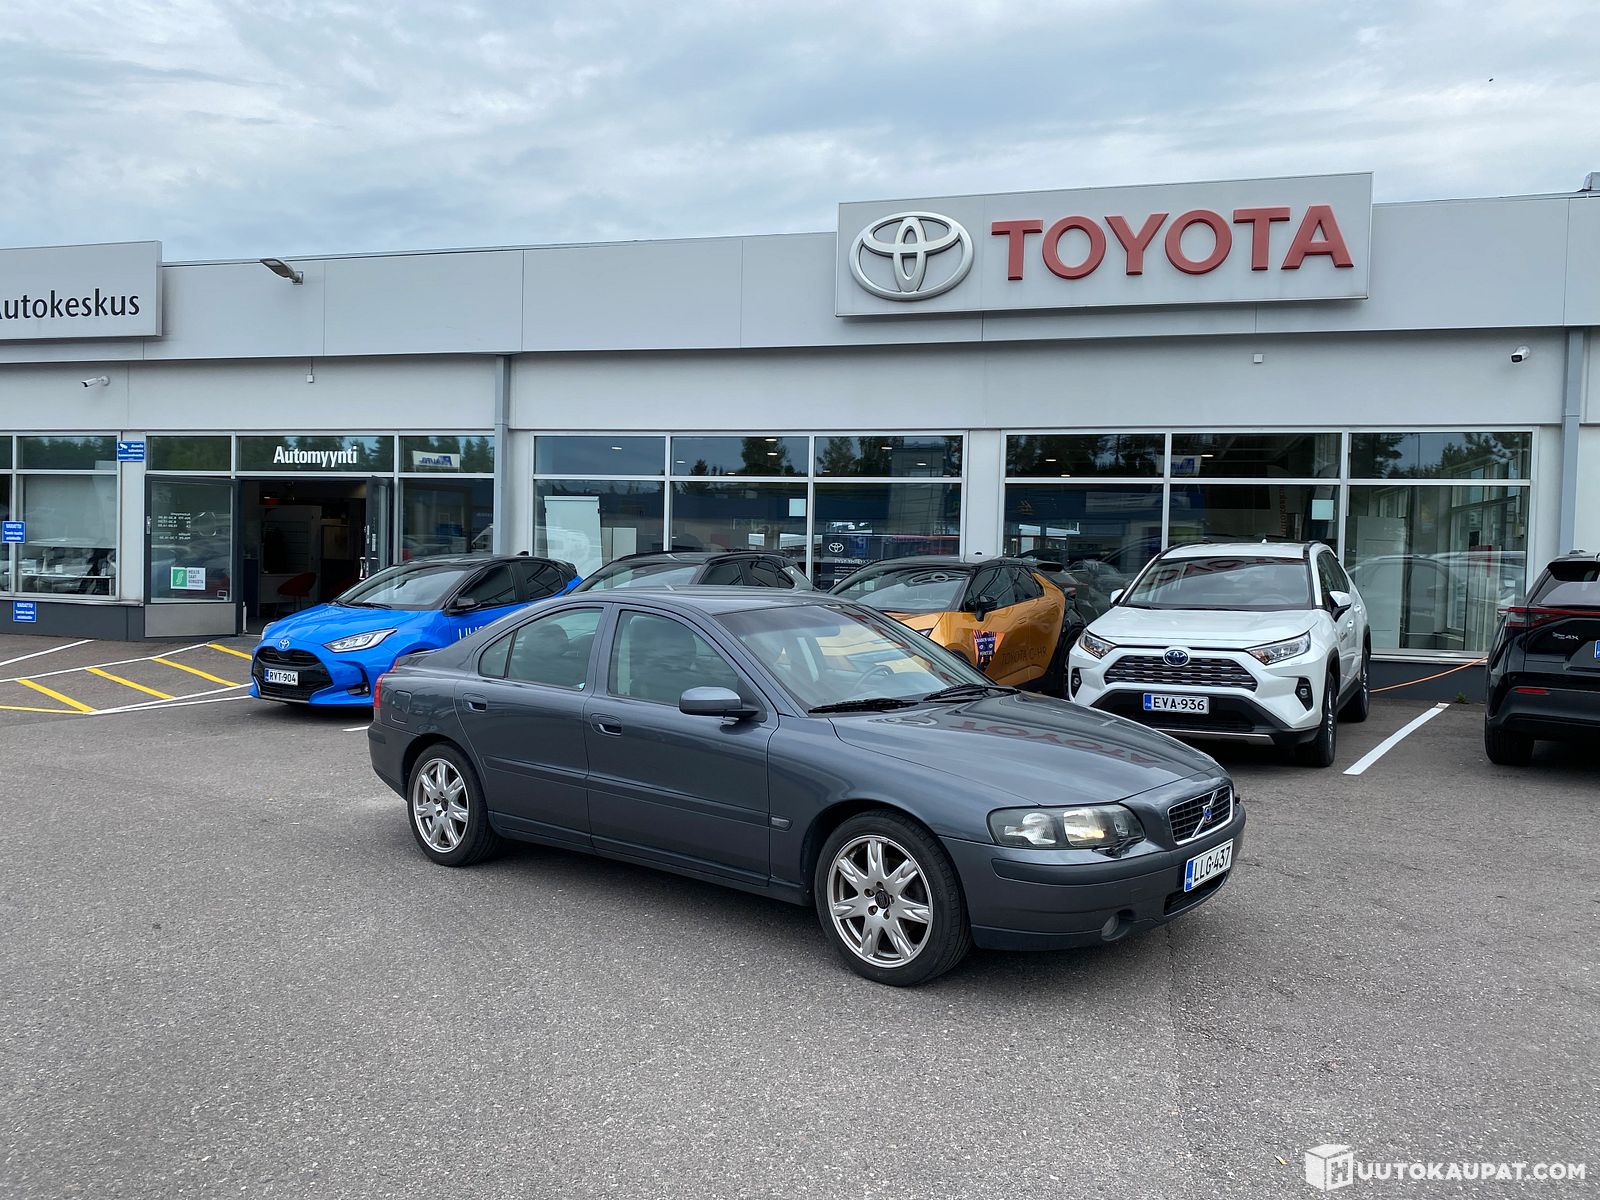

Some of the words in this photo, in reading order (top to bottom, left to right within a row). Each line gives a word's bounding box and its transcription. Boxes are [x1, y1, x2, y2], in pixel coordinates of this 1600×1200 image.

[991, 204, 1355, 281] TOYOTA
[0, 288, 140, 320] utokeskus
[273, 445, 357, 468] Automyynti
[269, 671, 296, 683] RVT-904
[1153, 696, 1205, 711] EVA-936
[1193, 845, 1231, 883] LLG-437
